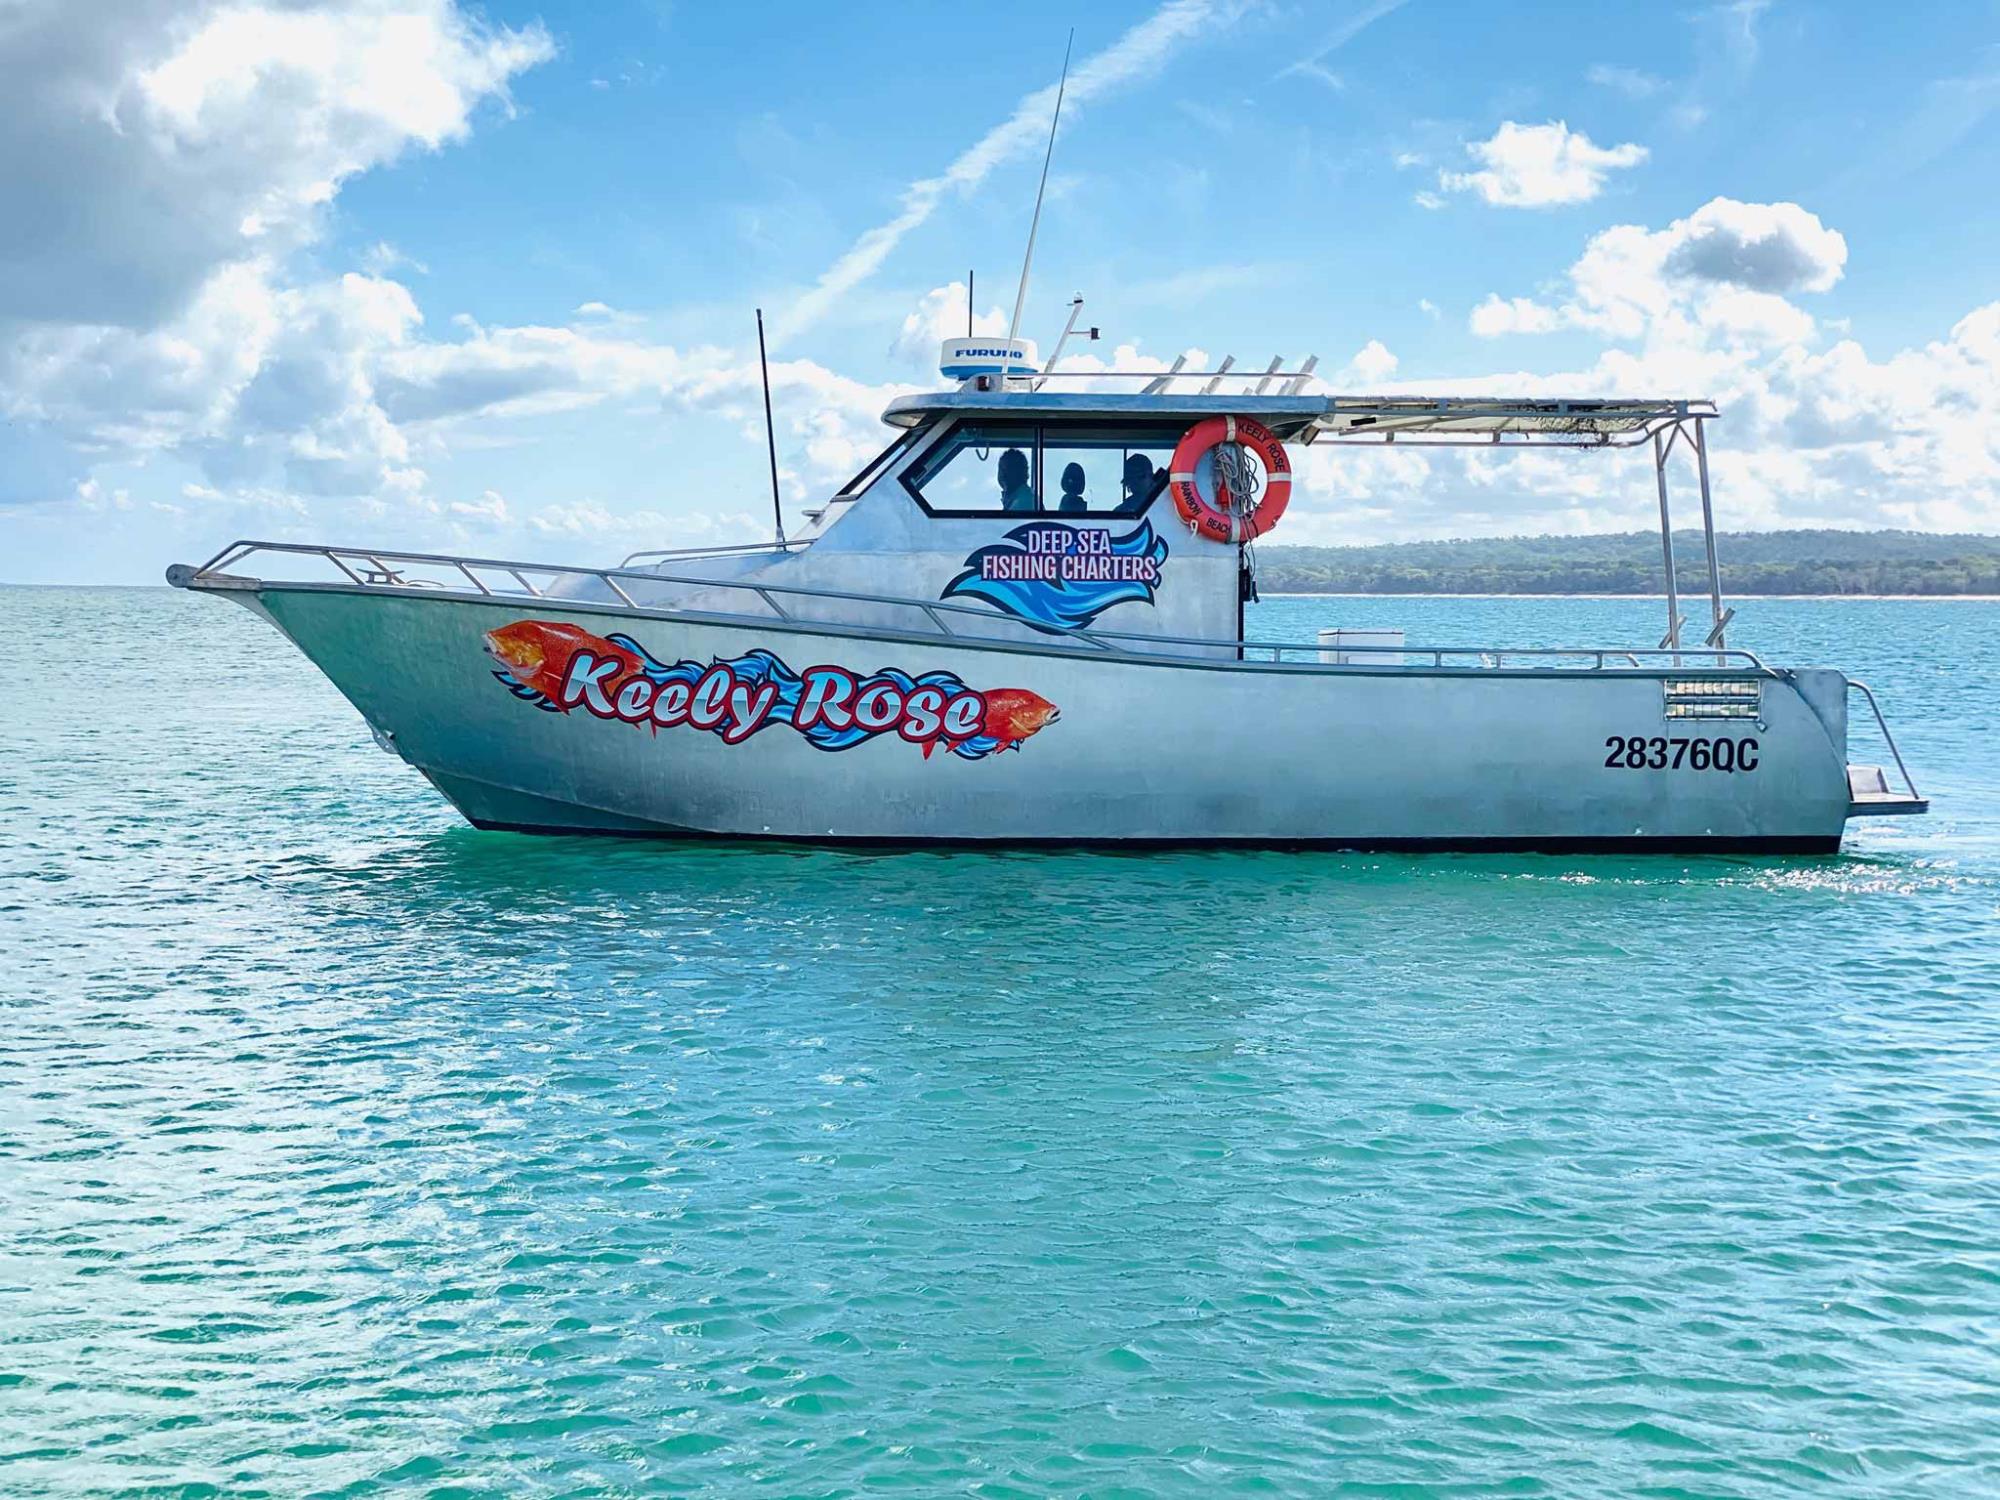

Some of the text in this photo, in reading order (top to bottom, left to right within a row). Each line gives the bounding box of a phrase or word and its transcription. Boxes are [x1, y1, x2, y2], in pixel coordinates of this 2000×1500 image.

[1238, 422, 1285, 472] KEELY ROSE
[1181, 481, 1231, 533] RAINBOW BEACH
[1028, 530, 1111, 554] DEEP SEA
[982, 555, 1156, 580] FISHING CHARTERS
[562, 652, 983, 741] Keely Rose
[1604, 736, 1759, 773] 28376QC
